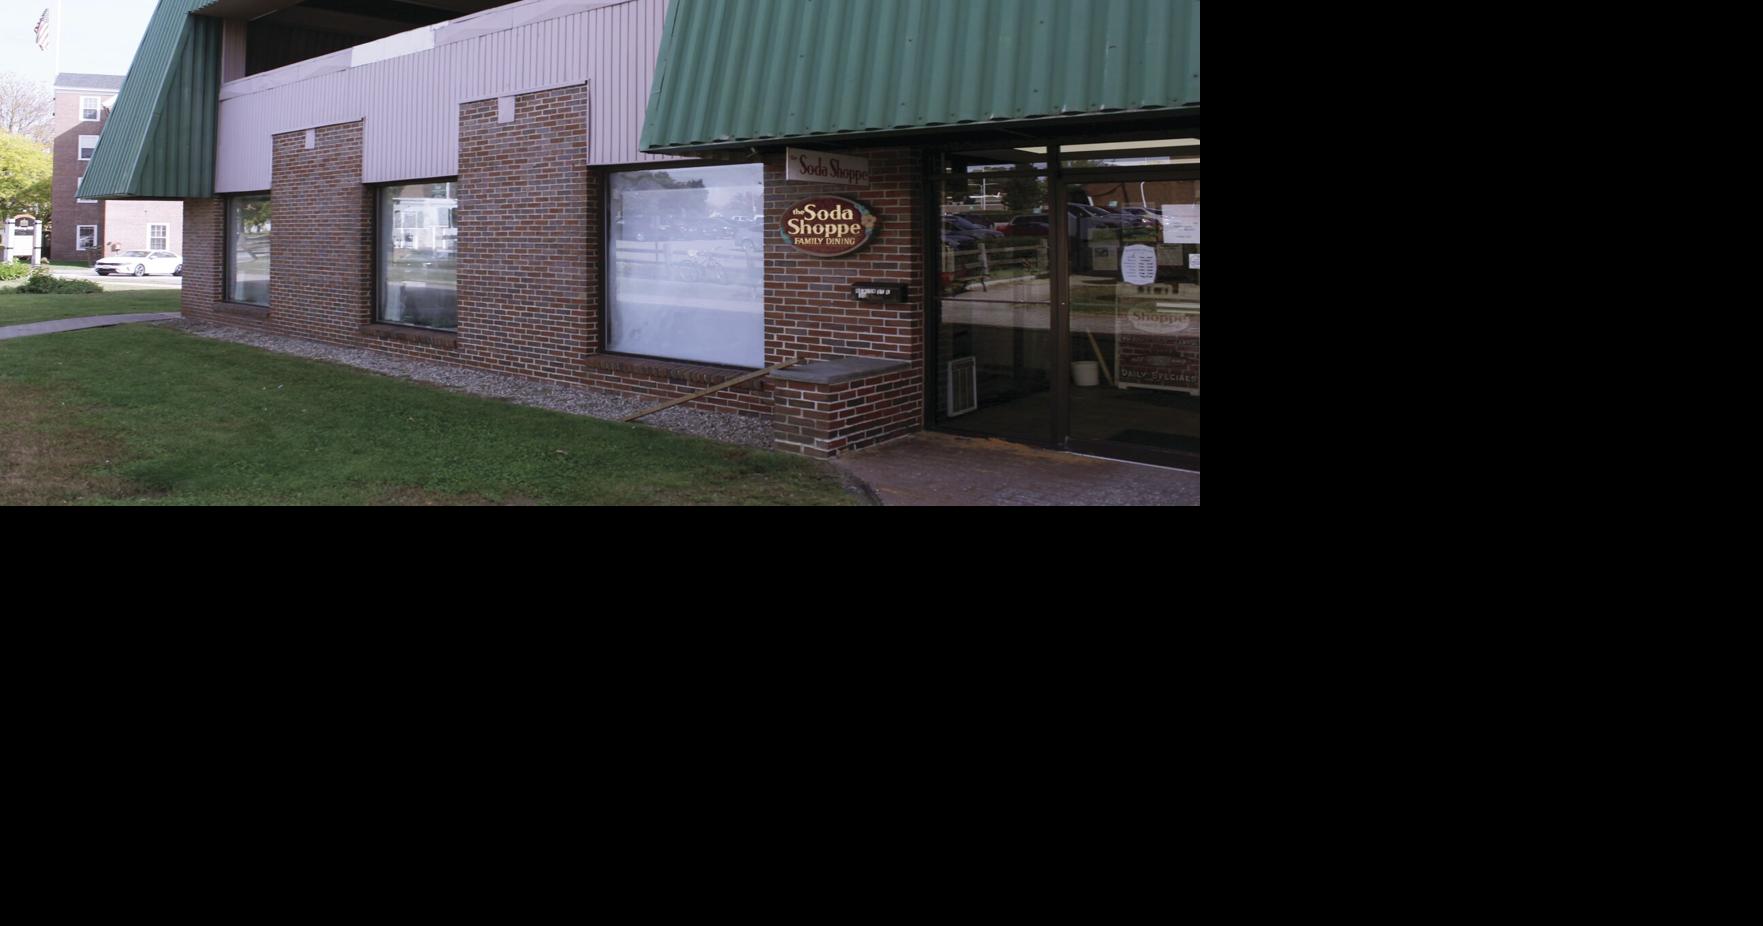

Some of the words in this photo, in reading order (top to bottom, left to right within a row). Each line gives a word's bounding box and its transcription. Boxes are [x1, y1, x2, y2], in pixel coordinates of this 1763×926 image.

[800, 155, 827, 176] Soda
[830, 159, 867, 184] Shoppe
[803, 203, 854, 221] Soda
[787, 218, 861, 238] Shoppe
[794, 237, 823, 245] FAMILY
[826, 237, 855, 245] DINING
[1133, 312, 1190, 324] Shoppe
